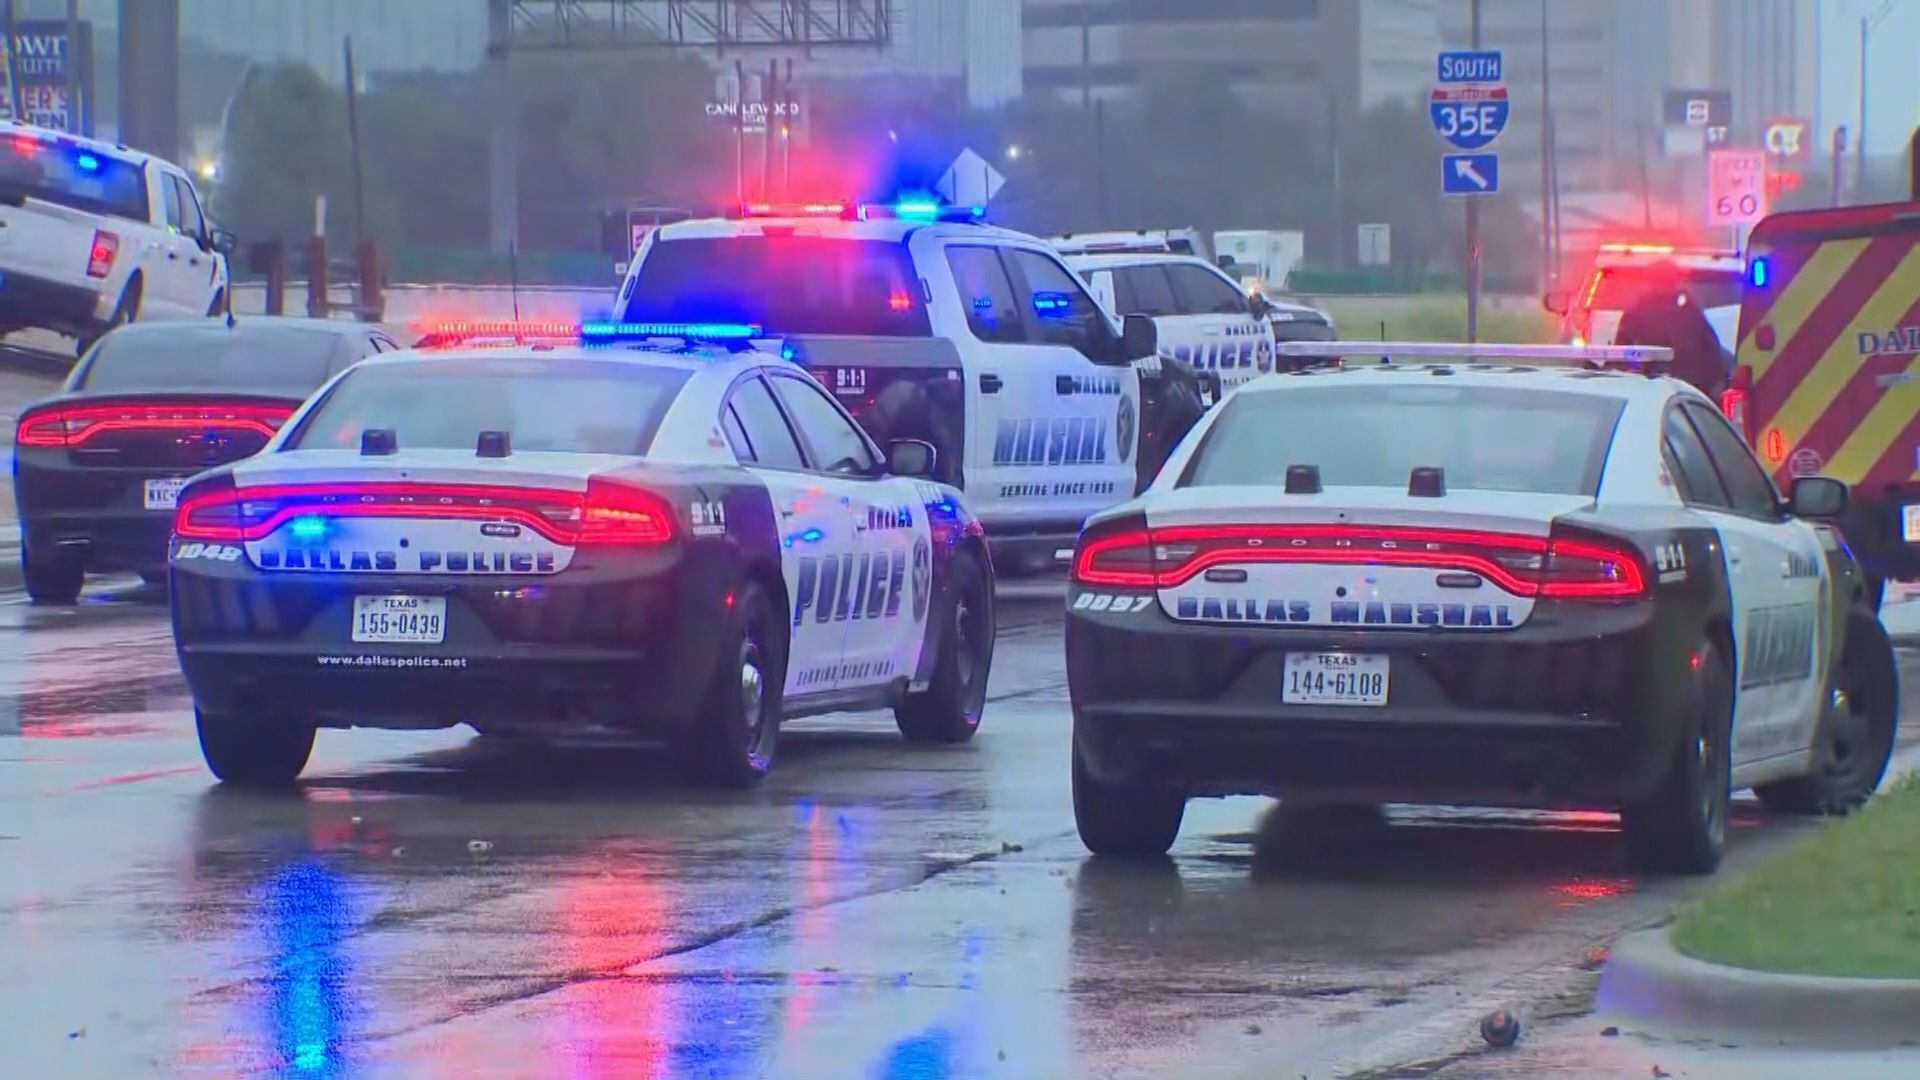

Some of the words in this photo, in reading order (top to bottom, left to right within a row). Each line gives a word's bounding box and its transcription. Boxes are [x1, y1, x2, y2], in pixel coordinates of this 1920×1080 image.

[1442, 57, 1498, 79] SOUTH
[1440, 106, 1497, 136] 35E
[1717, 193, 1757, 216] 60
[1163, 343, 1253, 370] OLICE
[1000, 484, 1047, 498] SERVING
[1053, 482, 1085, 496] SINCE
[260, 549, 397, 570] DALLAS
[420, 552, 554, 571] POLICE
[792, 552, 905, 627] POLICE
[384, 599, 418, 608] TEXAS
[1177, 597, 1310, 622] DALLAS
[1330, 600, 1513, 627] MARSHAL
[317, 655, 467, 668] www.dallaspolice.net
[1317, 655, 1358, 666] TEXAS
